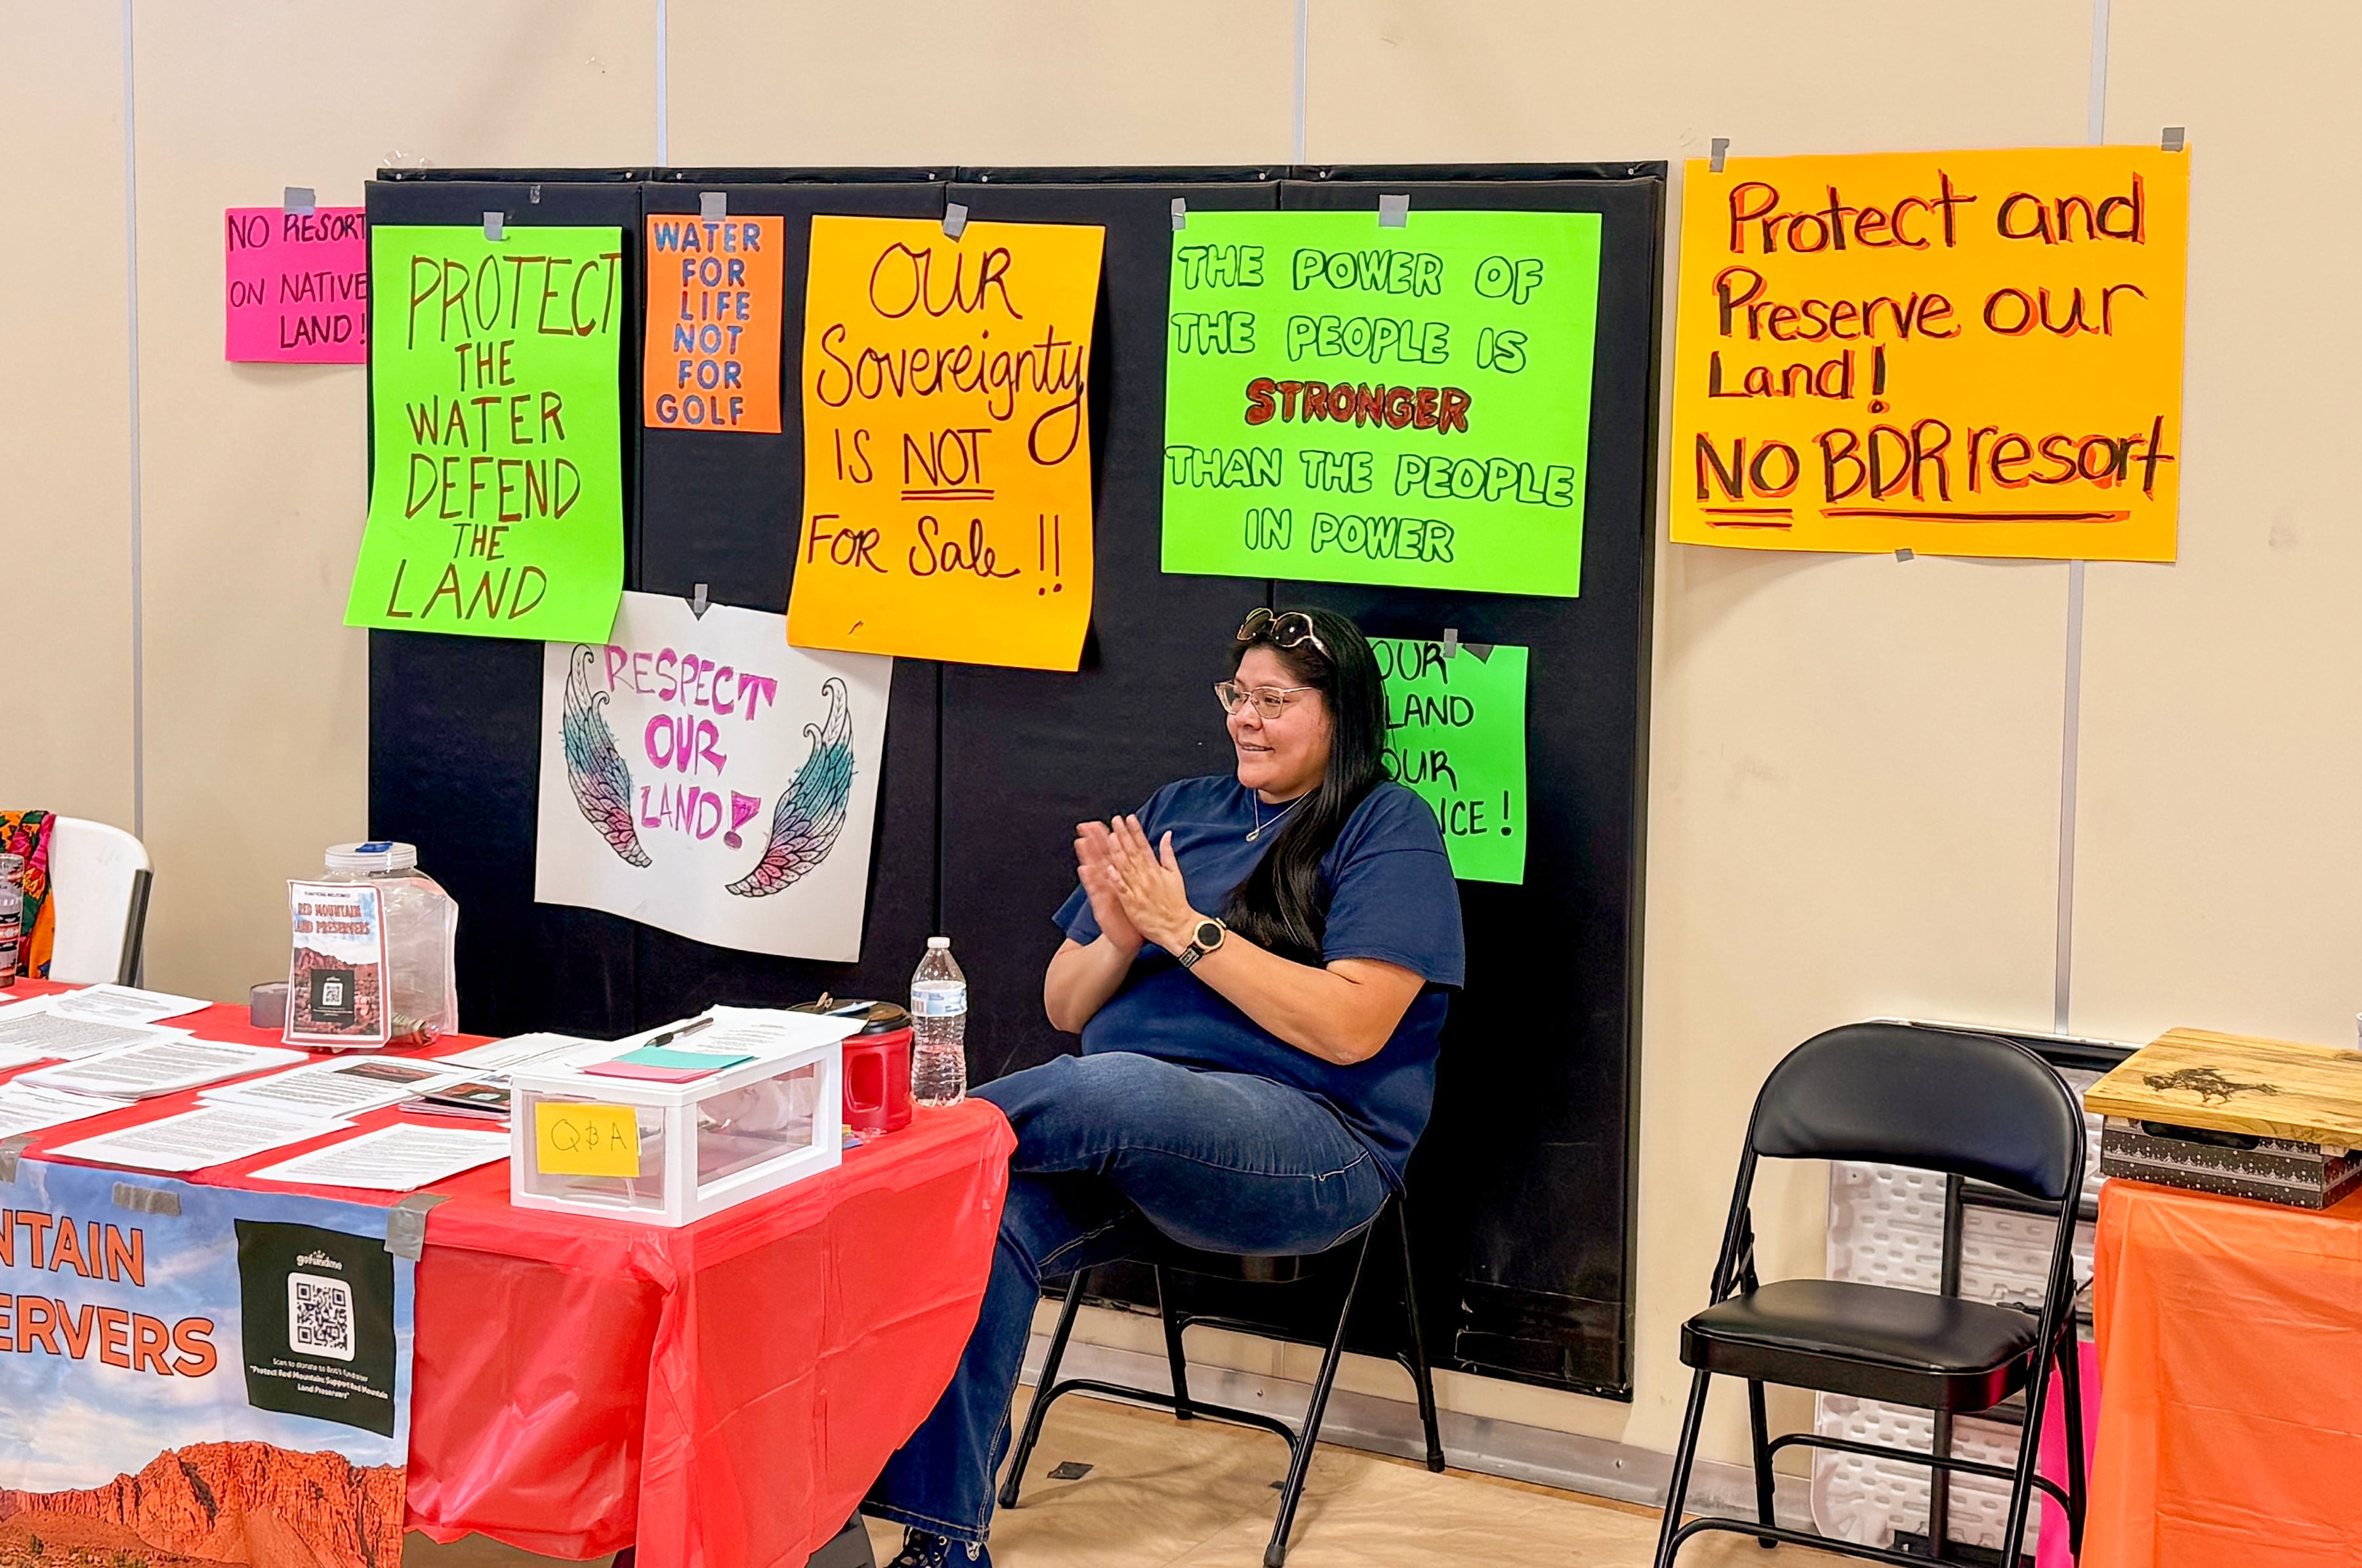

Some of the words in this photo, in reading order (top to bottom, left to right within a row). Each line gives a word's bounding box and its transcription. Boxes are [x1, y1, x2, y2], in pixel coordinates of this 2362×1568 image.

[228, 215, 270, 251] NO
[283, 213, 365, 242] RESORT
[654, 222, 760, 253] WATER
[1729, 169, 1977, 254] Protect
[1997, 171, 2145, 246] and
[230, 278, 264, 307] ON
[280, 271, 367, 304] NATIVE
[682, 257, 745, 287] FOR
[869, 241, 1023, 320] OUR
[1178, 245, 1264, 289] THE
[1293, 249, 1443, 297] POWER
[1475, 256, 1543, 304] OF
[408, 253, 621, 349] PROTECT
[681, 291, 750, 321] LIFE
[1712, 266, 1962, 343] Preserve
[1983, 283, 2149, 337] our
[280, 312, 365, 348] LAND!
[673, 324, 743, 354] NOT
[1171, 311, 1255, 355] THE
[1287, 316, 1449, 363] PEOPLE
[1477, 328, 1527, 373] IS
[455, 340, 515, 392] THE
[678, 359, 741, 389] FOR
[816, 323, 1085, 465] Sovereignty
[1709, 343, 1890, 415] Land!
[406, 391, 565, 451] WATER
[656, 394, 744, 425] GOLF
[1245, 378, 1471, 434] STRONGER
[835, 428, 873, 484] IS
[903, 428, 991, 485] NOT
[1164, 446, 1281, 487] THAN
[1300, 449, 1373, 493] THE
[1395, 453, 1574, 506] PEOPLE
[1812, 419, 1952, 503] BDR
[1966, 415, 2176, 501] resort
[405, 453, 581, 522] DEFEND
[453, 523, 509, 560] THE
[909, 515, 1020, 578] Sale
[1245, 508, 1291, 550] IN
[1312, 512, 1454, 562] POWER
[386, 559, 547, 619] LAND
[604, 644, 778, 721] RESPECT
[1372, 640, 1447, 684] OUR
[1385, 694, 1474, 730] LAND
[645, 714, 728, 777] OUR
[1382, 748, 1457, 792] OUR
